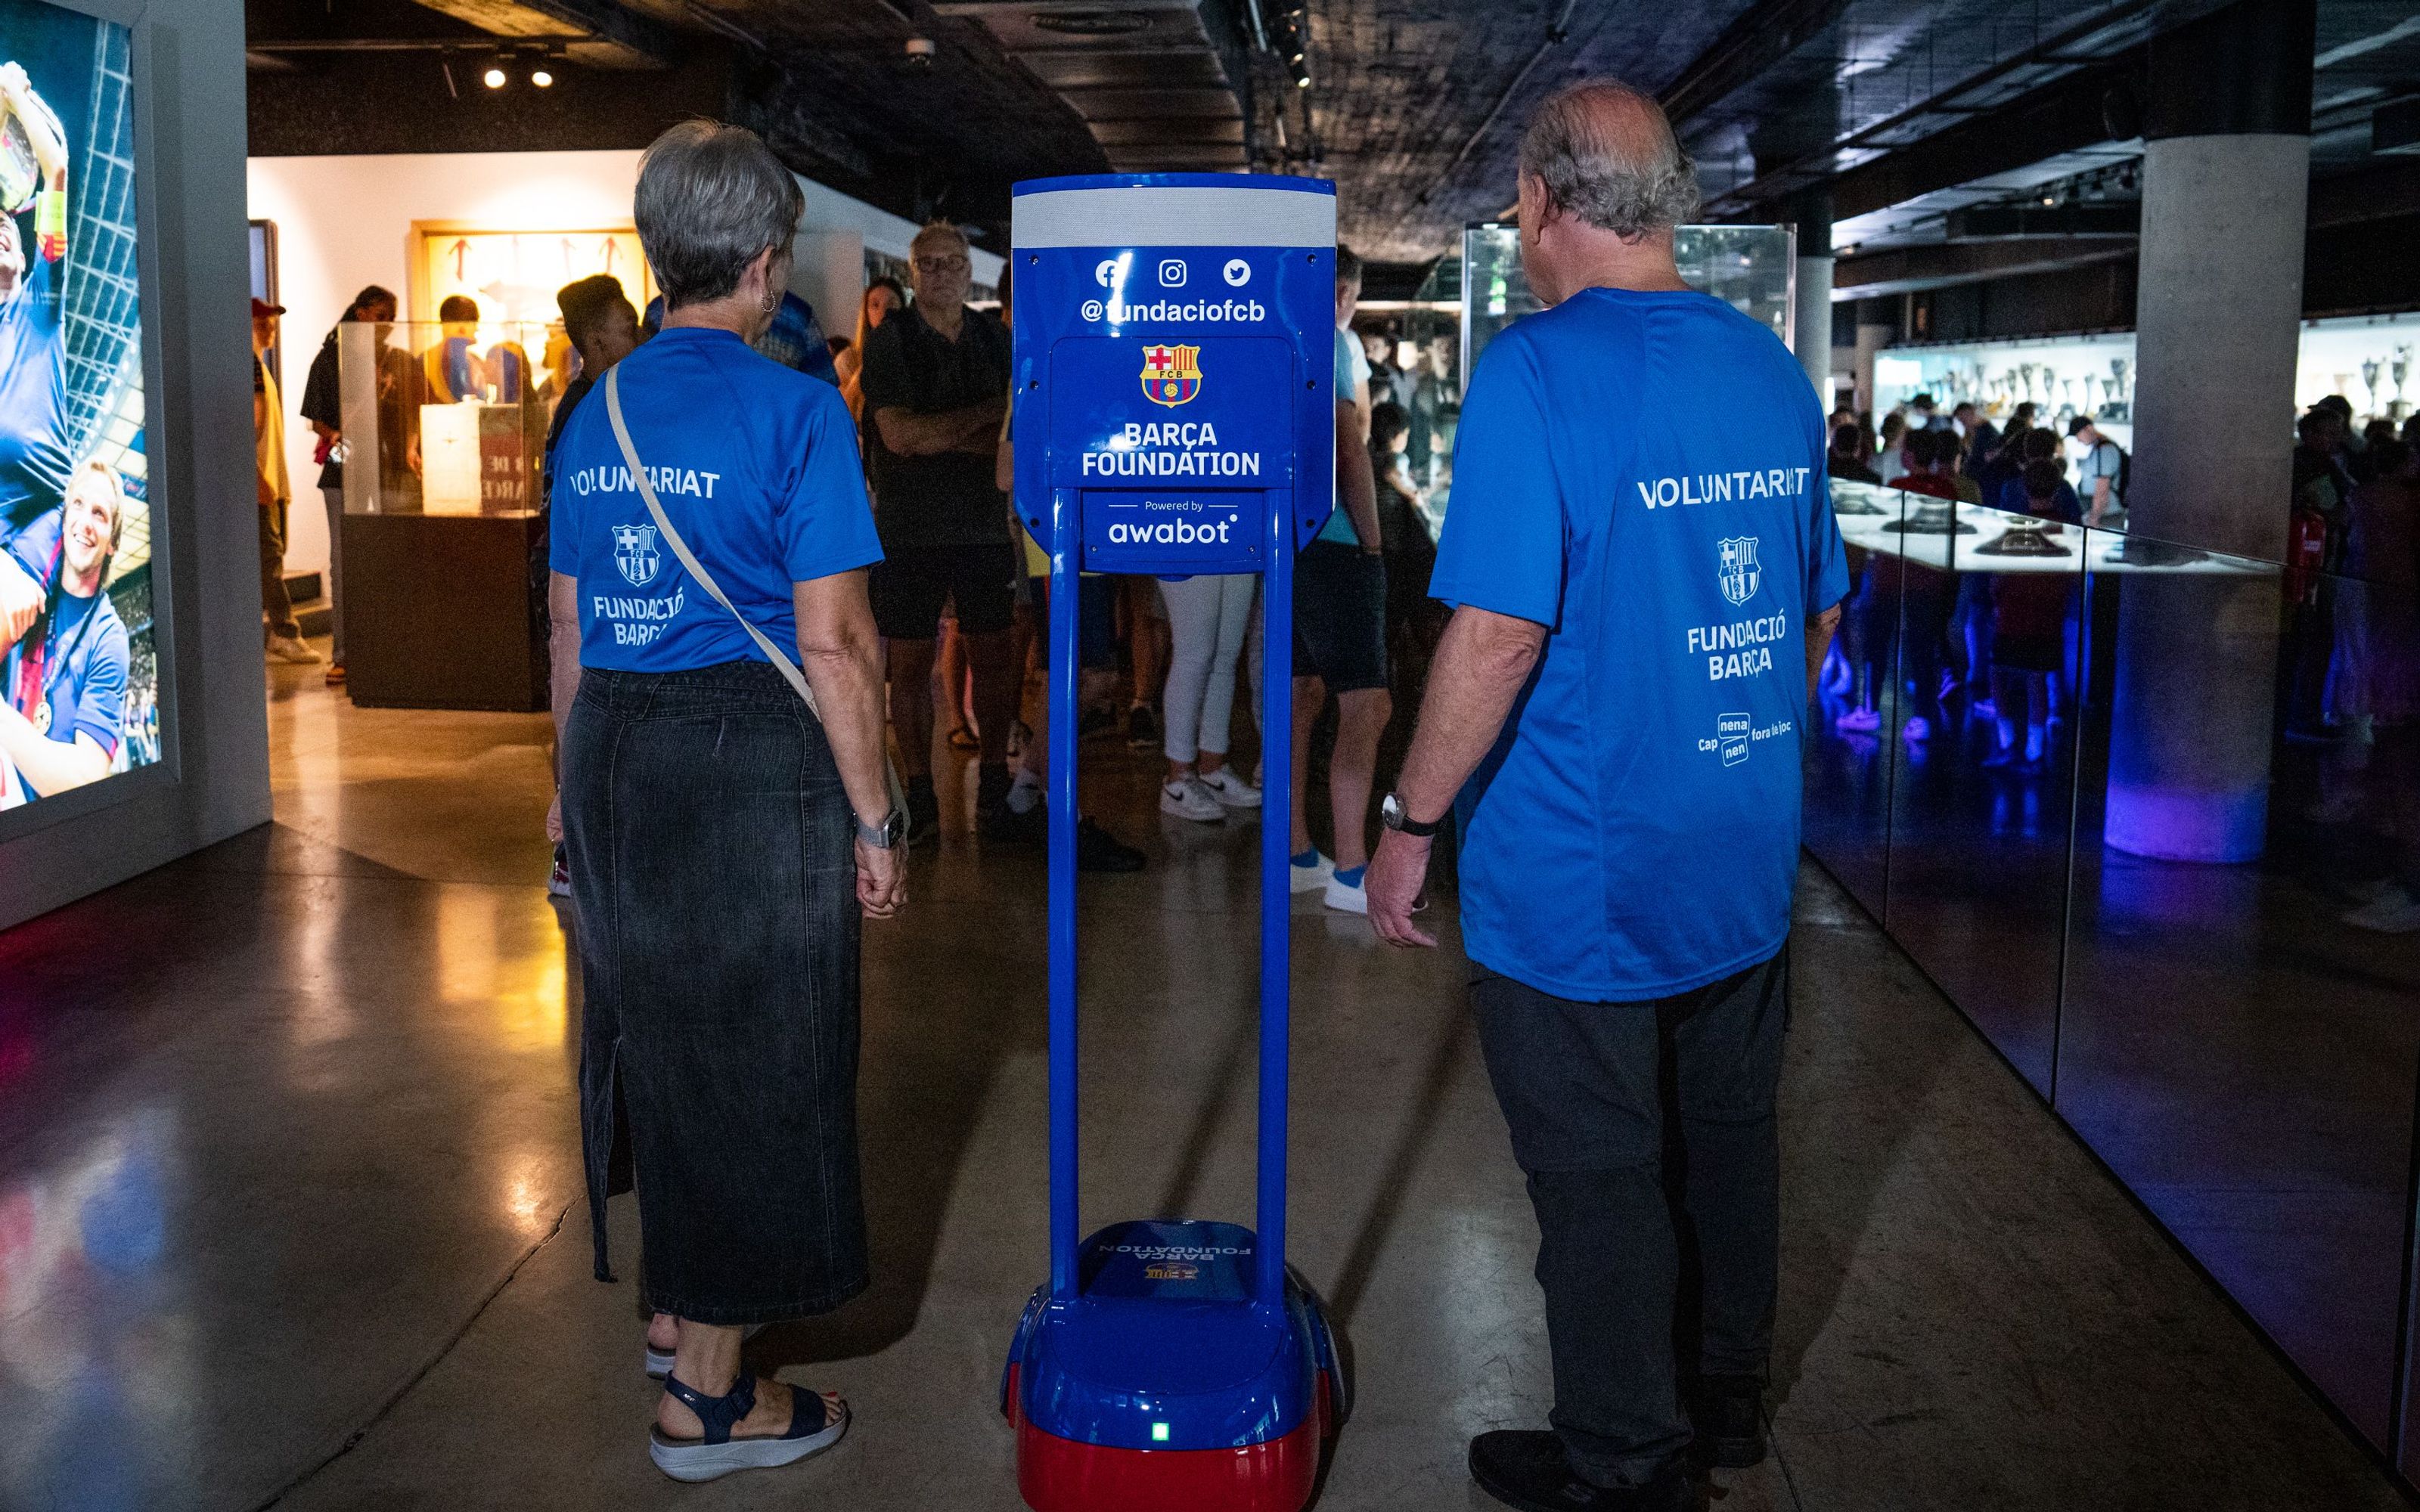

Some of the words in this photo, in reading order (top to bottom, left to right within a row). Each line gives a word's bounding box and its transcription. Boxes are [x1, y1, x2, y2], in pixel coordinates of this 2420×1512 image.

[1081, 299, 1265, 322] @fundaciofcb
[1159, 370, 1183, 379] FCB
[1125, 423, 1218, 451] BARÇA
[1082, 452, 1260, 476] FOUNDATION
[569, 466, 721, 499] VOLUNARIAT
[1637, 467, 1810, 510] VOLUNTARIAT
[1145, 500, 1189, 511] Powered
[1191, 500, 1203, 513] by
[1109, 517, 1230, 544] awabot
[593, 586, 684, 621] FUNDACIÓ
[1687, 607, 1786, 654] FUNDACIÓ
[1709, 647, 1773, 680] BARÇA
[1720, 720, 1748, 732] nena
[1751, 728, 1770, 741] fora
[1771, 723, 1779, 736] de
[1779, 720, 1791, 736] joc
[1699, 739, 1718, 751] Cap
[1725, 743, 1745, 759] nen
[1099, 1245, 1251, 1255] FOUNDATION
